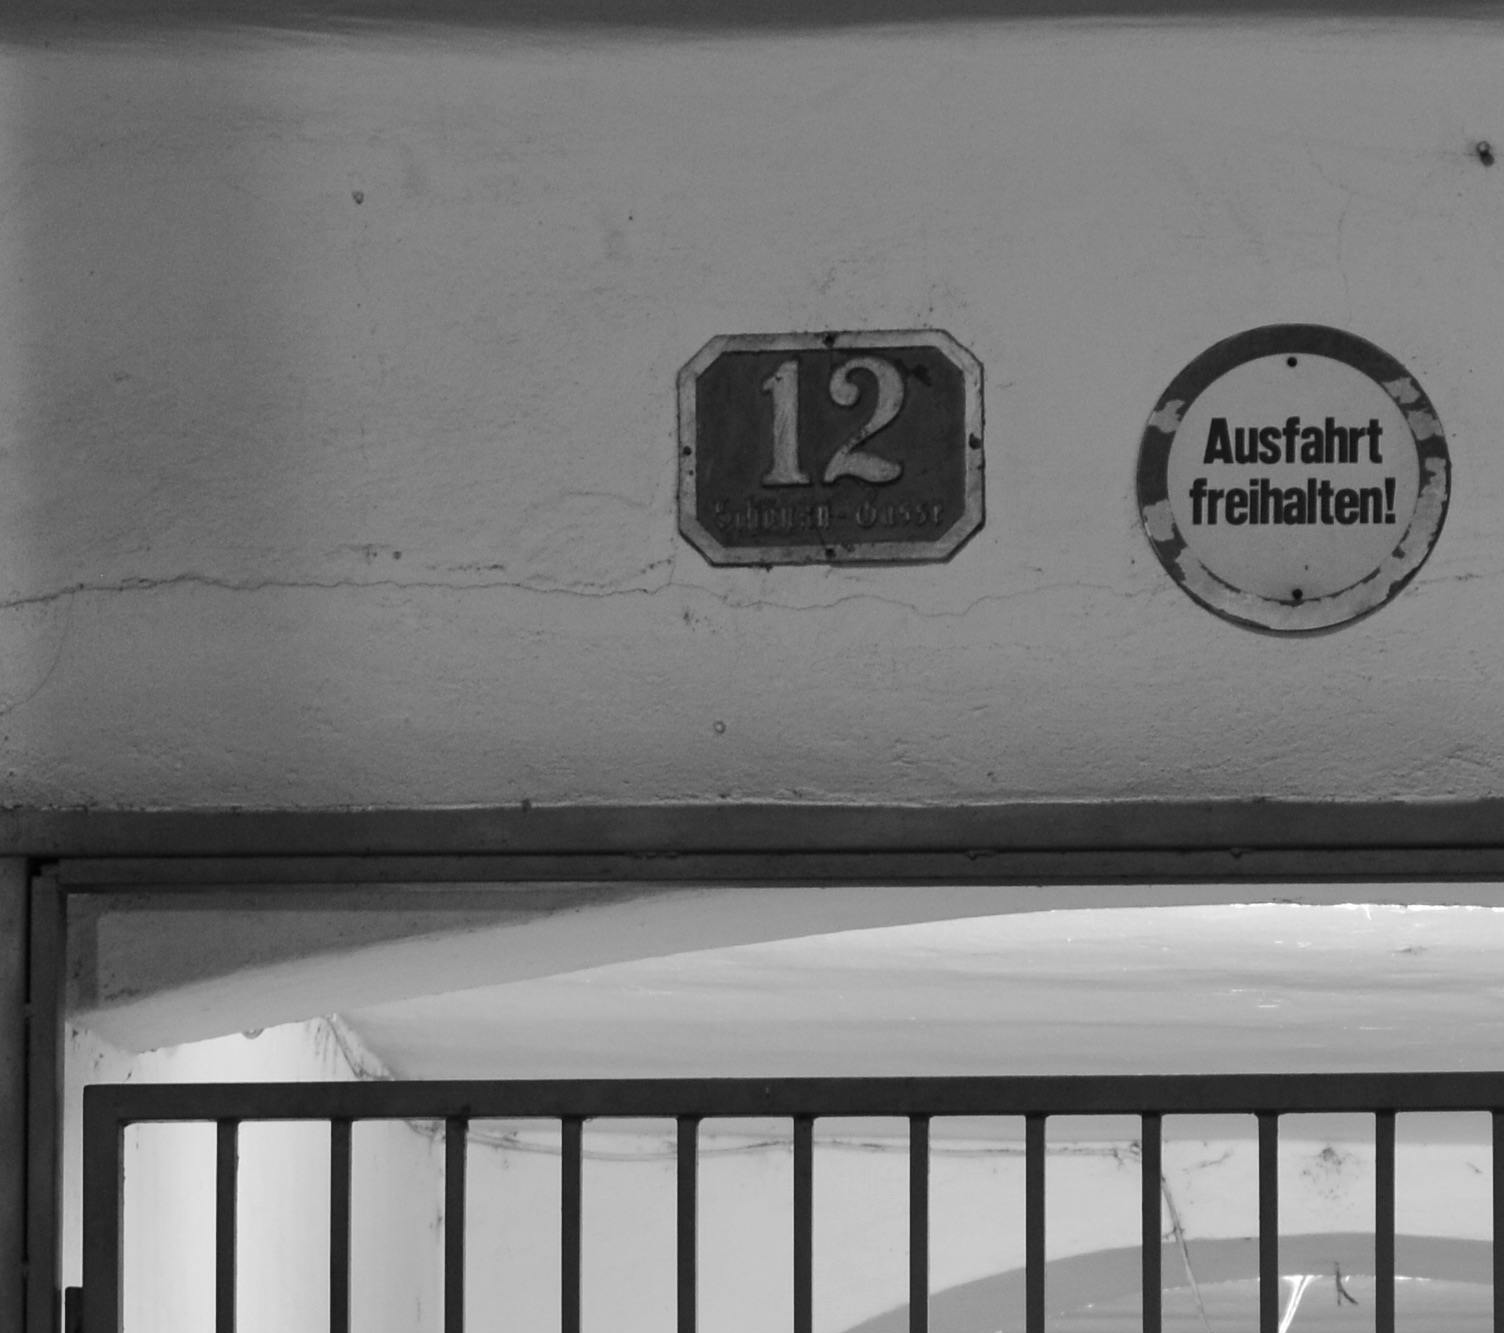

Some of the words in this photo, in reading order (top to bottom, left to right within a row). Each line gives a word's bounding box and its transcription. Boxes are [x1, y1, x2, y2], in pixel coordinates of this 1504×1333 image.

[761, 356, 906, 486] 12
[1202, 415, 1384, 466] Ausfahrt
[1188, 476, 1397, 527] freihalten!
